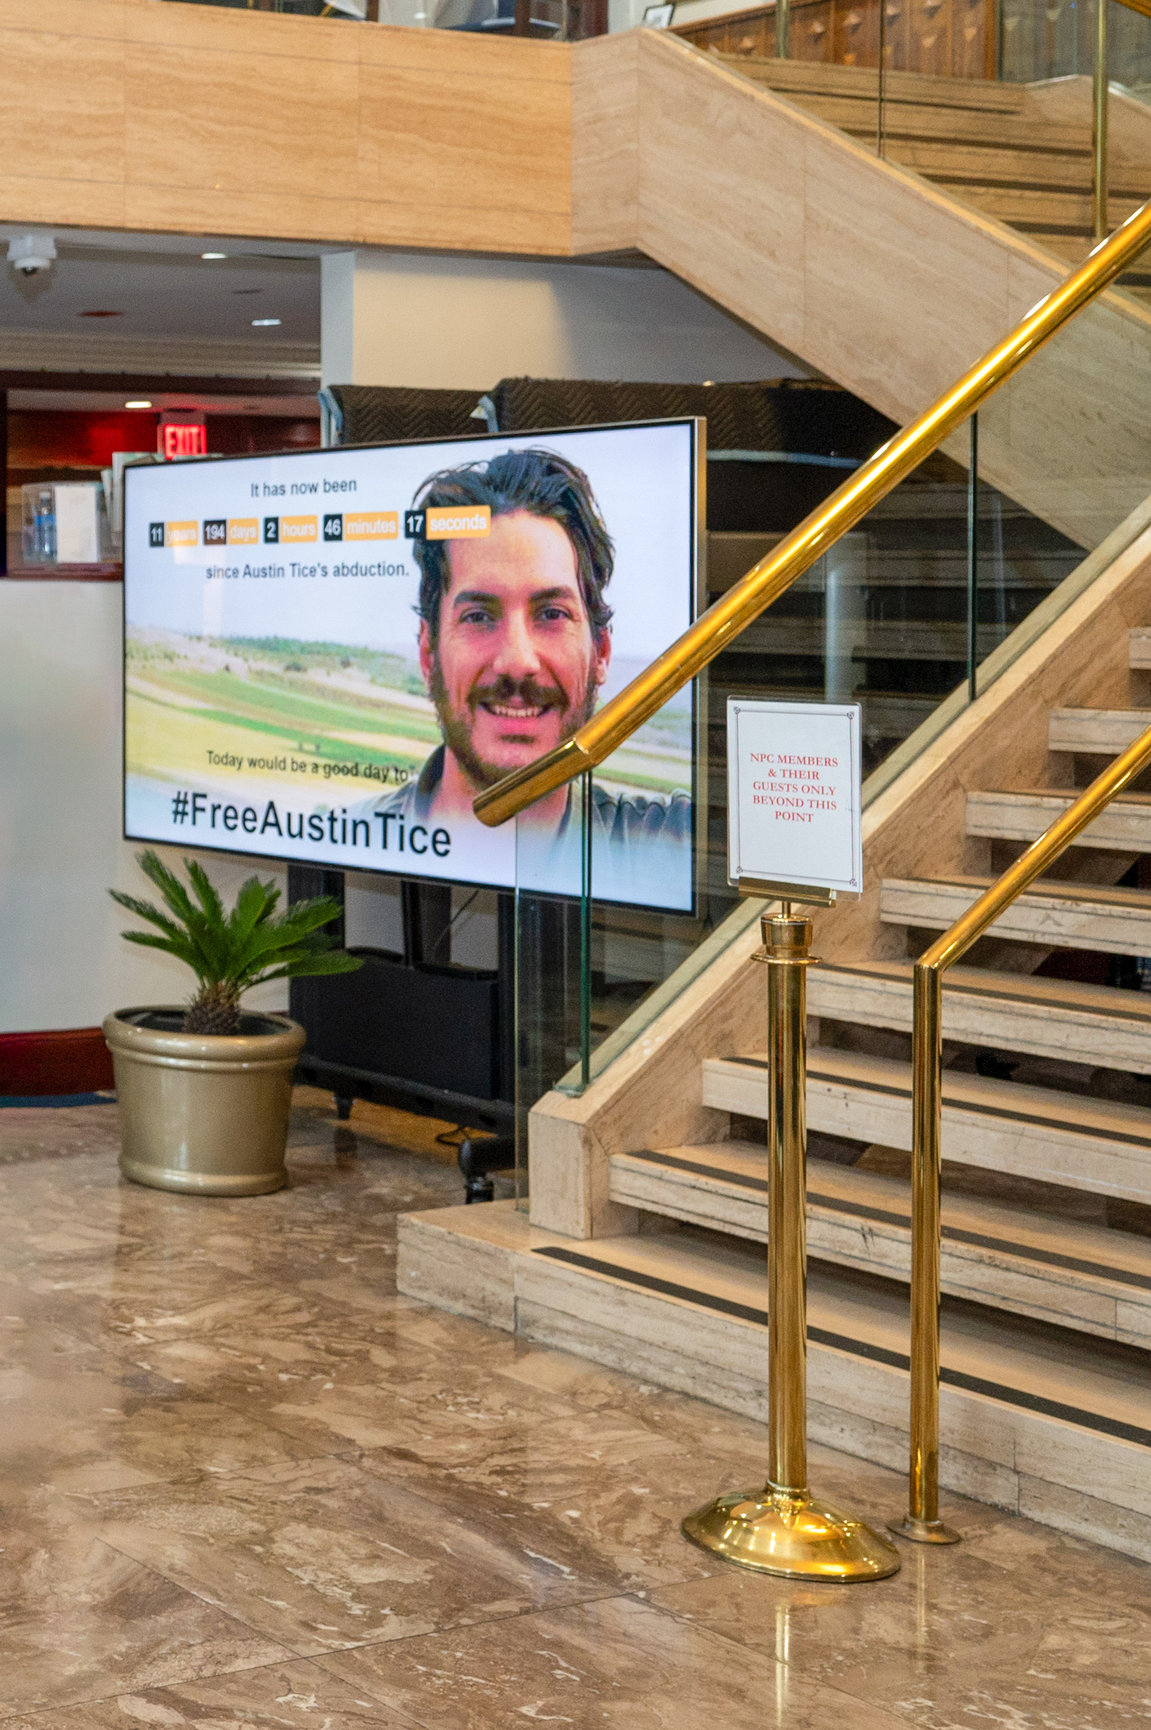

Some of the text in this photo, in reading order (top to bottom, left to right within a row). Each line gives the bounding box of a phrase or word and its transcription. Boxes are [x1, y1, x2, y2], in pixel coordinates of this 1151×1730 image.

[165, 426, 199, 458] EXIT
[251, 479, 357, 497] It has now been
[151, 513, 488, 544] 11 years 194 days 2 hours 46 minutes 17 seconds
[206, 561, 410, 579] since Austin Tice's abduction.
[207, 751, 408, 784] Today would be a good day to
[750, 753, 838, 767] NPC MEMBERS
[768, 768, 820, 780] & THEIR
[753, 781, 836, 796] GUESTS ONLY
[753, 795, 837, 810] BEYOND THIS
[171, 791, 452, 858] #FreeAustinTice
[775, 811, 814, 823] POINT
